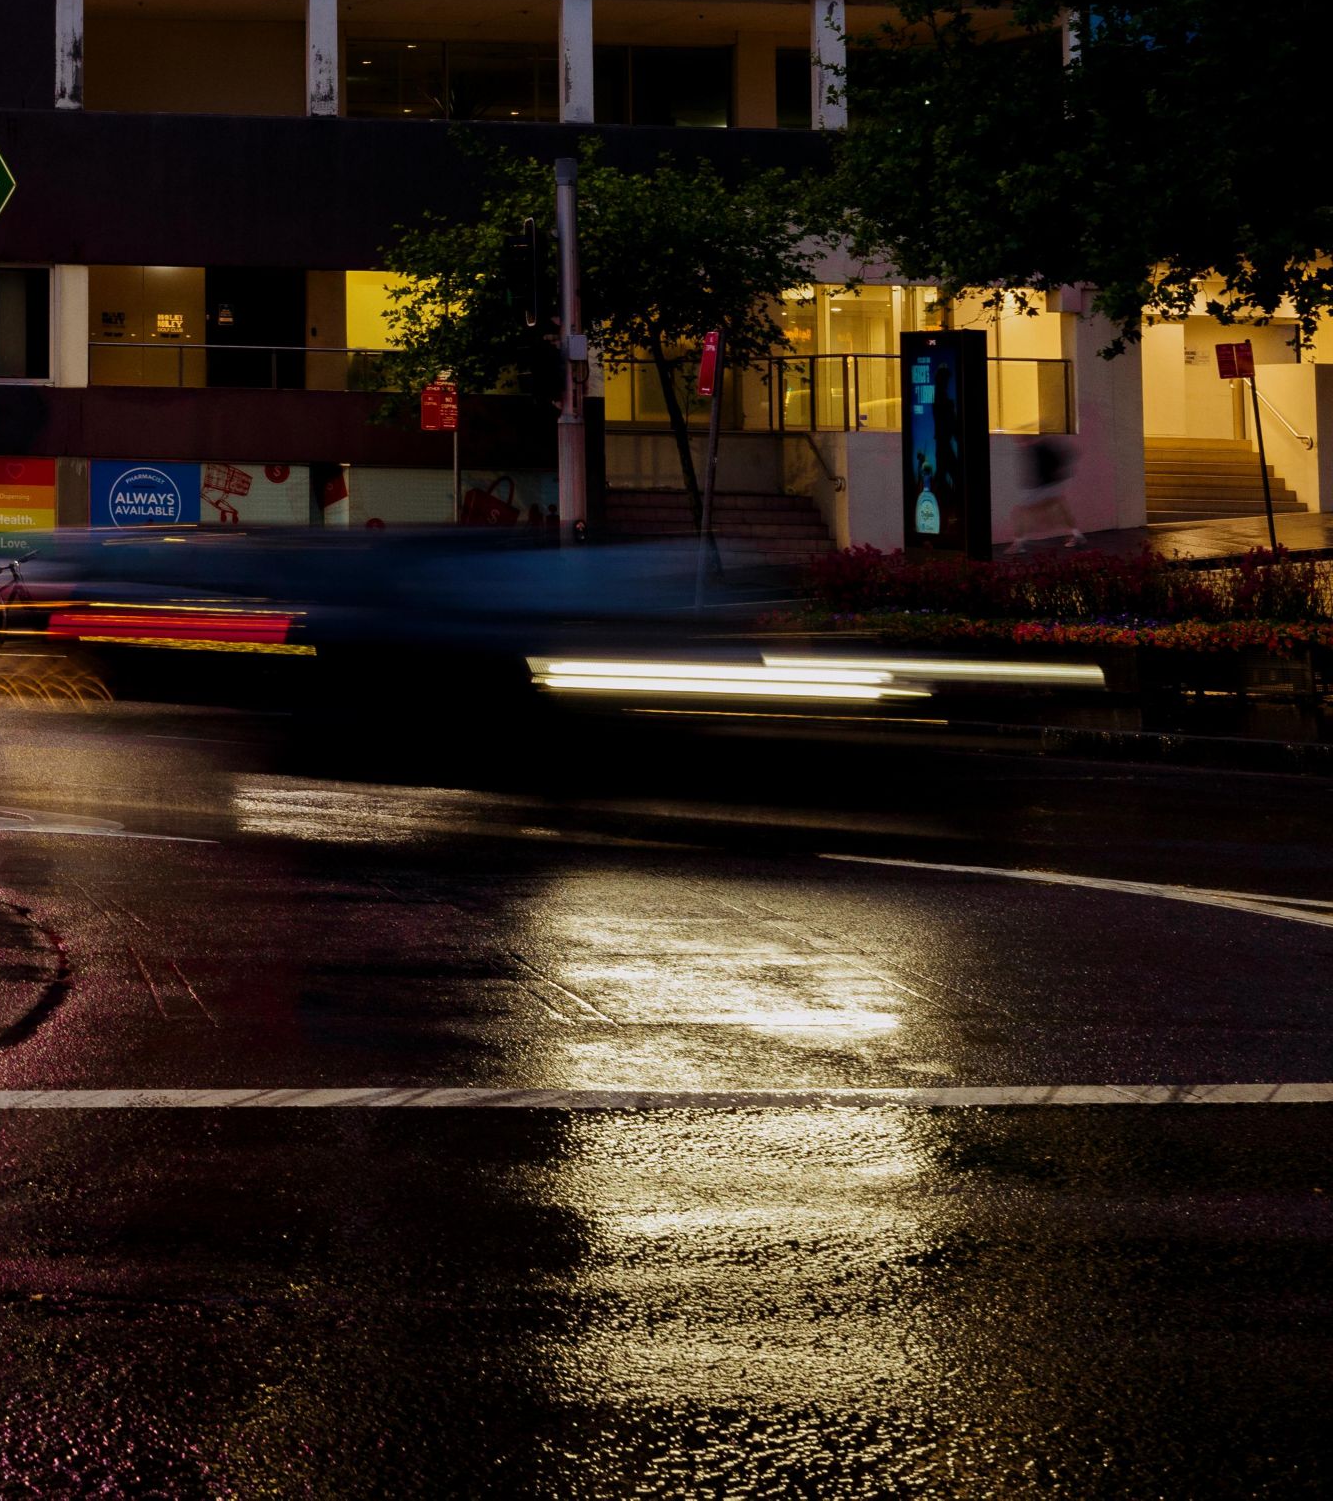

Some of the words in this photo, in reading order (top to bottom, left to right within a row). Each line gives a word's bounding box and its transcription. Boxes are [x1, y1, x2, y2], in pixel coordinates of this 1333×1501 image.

[125, 473, 165, 485] PHARMACIST
[115, 492, 175, 505] ALWAYS
[115, 506, 175, 517] AVAILABLE
[0, 537, 30, 549] Love.
